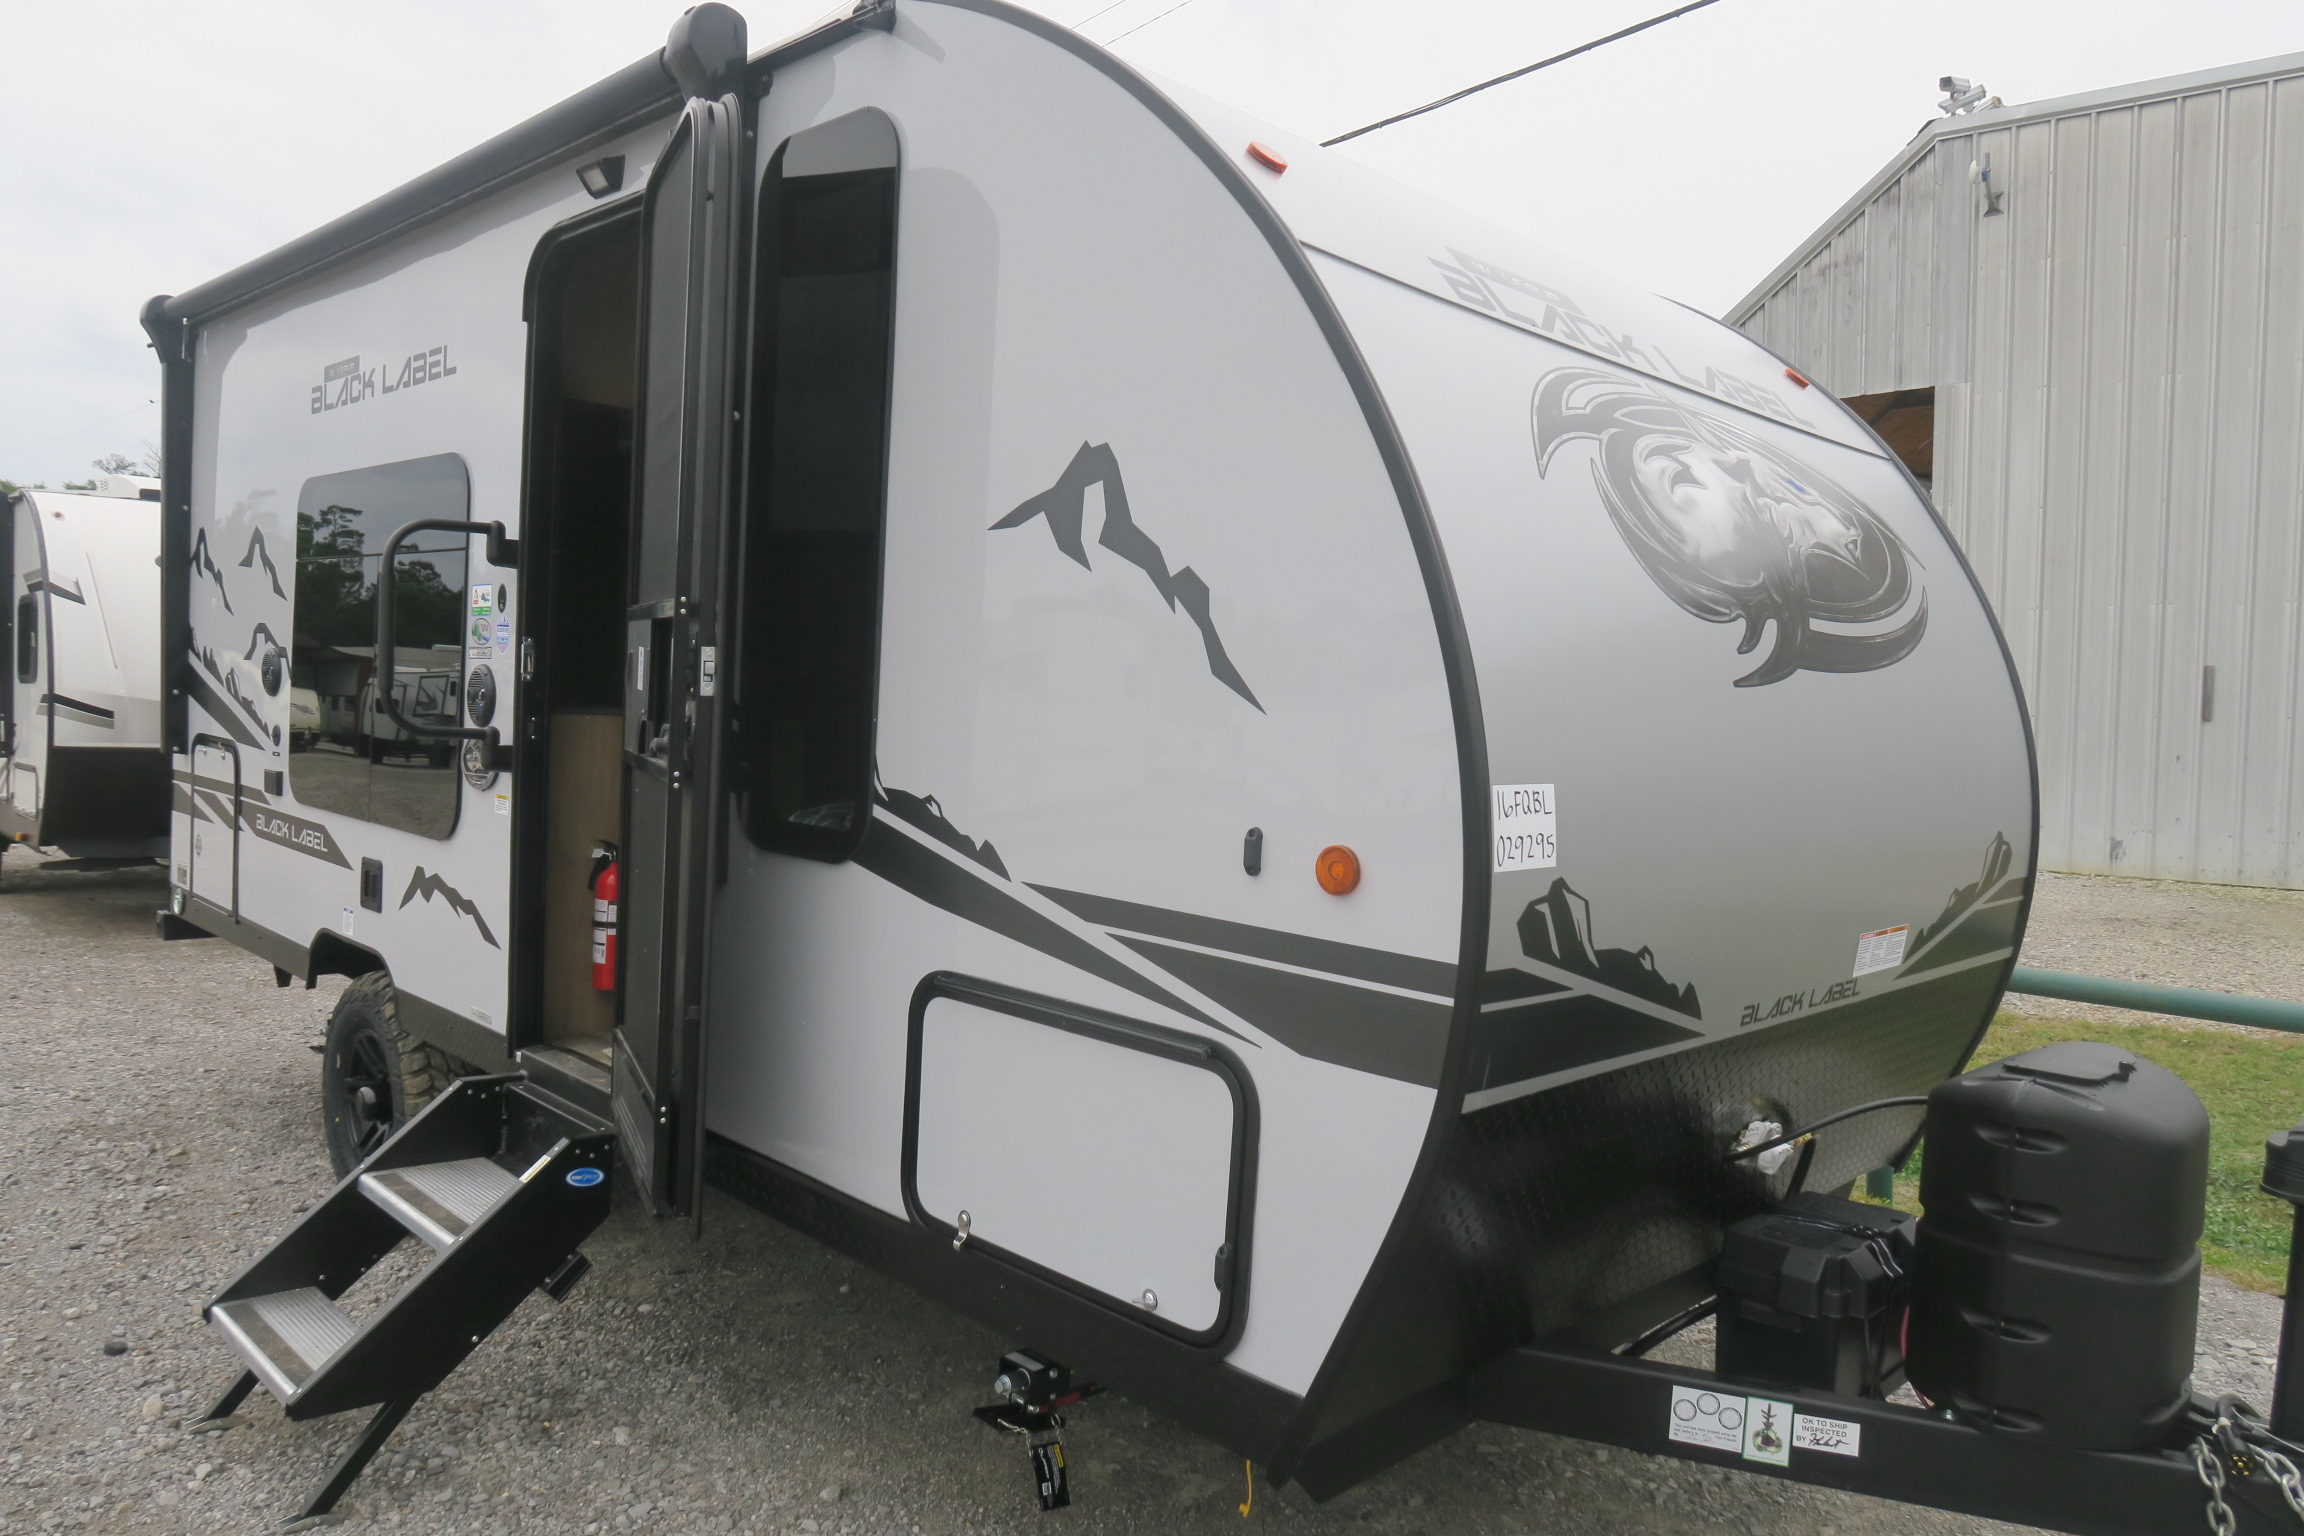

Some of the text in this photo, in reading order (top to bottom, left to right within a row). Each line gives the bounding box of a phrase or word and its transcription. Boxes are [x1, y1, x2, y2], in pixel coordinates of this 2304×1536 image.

[1427, 257, 1660, 372] BLACK
[1652, 344, 1817, 430] LABEL
[311, 345, 457, 414] BLACK LABEL
[1497, 789, 1553, 820] 16FQBL
[256, 813, 328, 852] BLACK LABEL
[1496, 833, 1555, 867] 029295
[1740, 978, 1860, 1027] BLACK LABEL
[1796, 1434, 1807, 1442] BY
[1801, 1425, 1848, 1438] INSPECTED
[1802, 1417, 1848, 1430] OK TO SHIP
